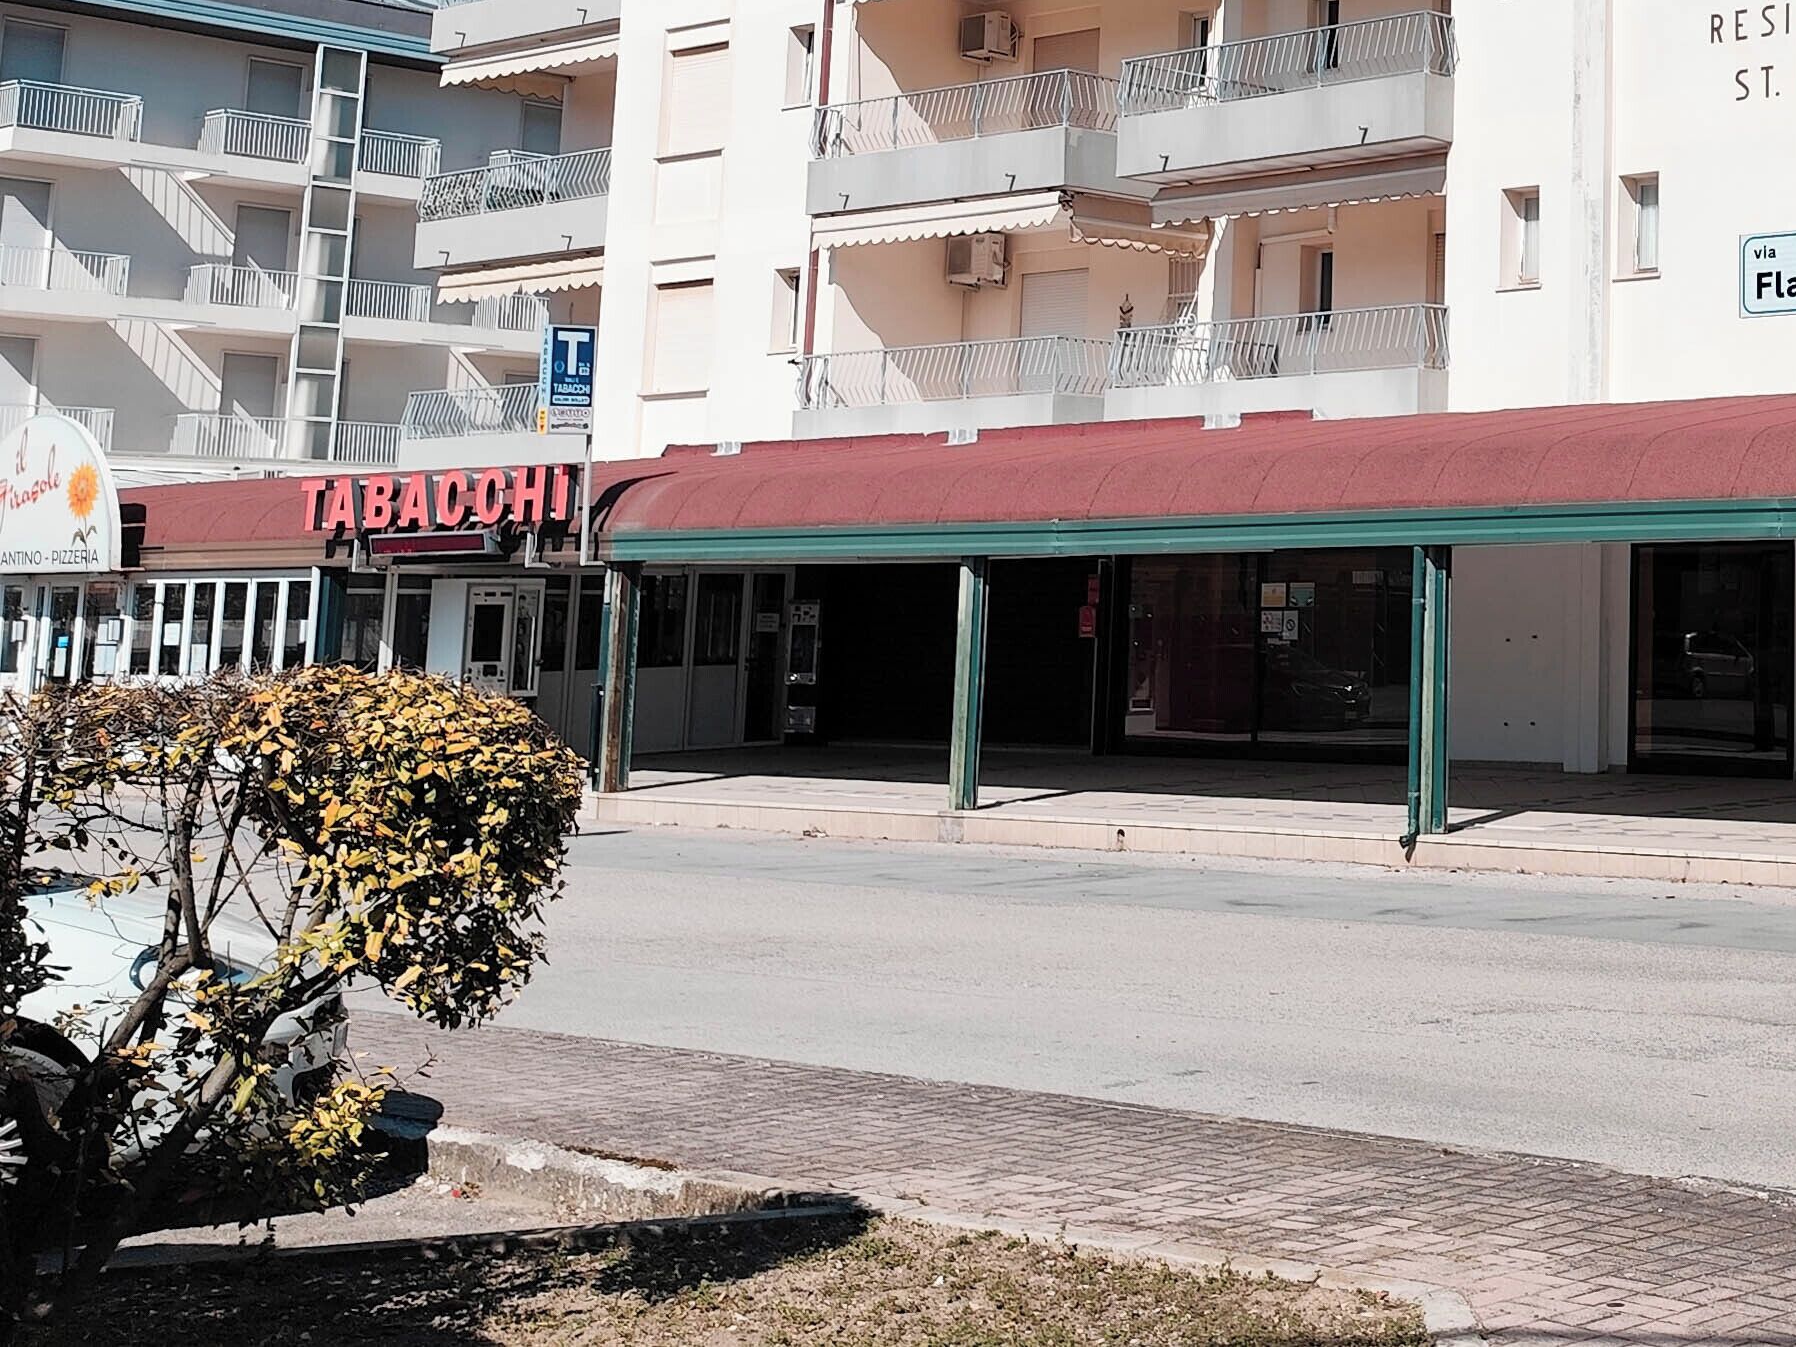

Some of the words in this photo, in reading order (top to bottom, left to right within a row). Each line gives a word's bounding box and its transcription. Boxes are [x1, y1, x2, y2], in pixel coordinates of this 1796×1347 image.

[1734, 65, 1781, 101] ST.
[1753, 245, 1777, 259] via
[557, 330, 590, 375] T
[553, 383, 591, 394] TABACCHI
[15, 426, 29, 475] il
[300, 464, 570, 532] TABACCHI
[51, 549, 99, 565] PIZZERIA
